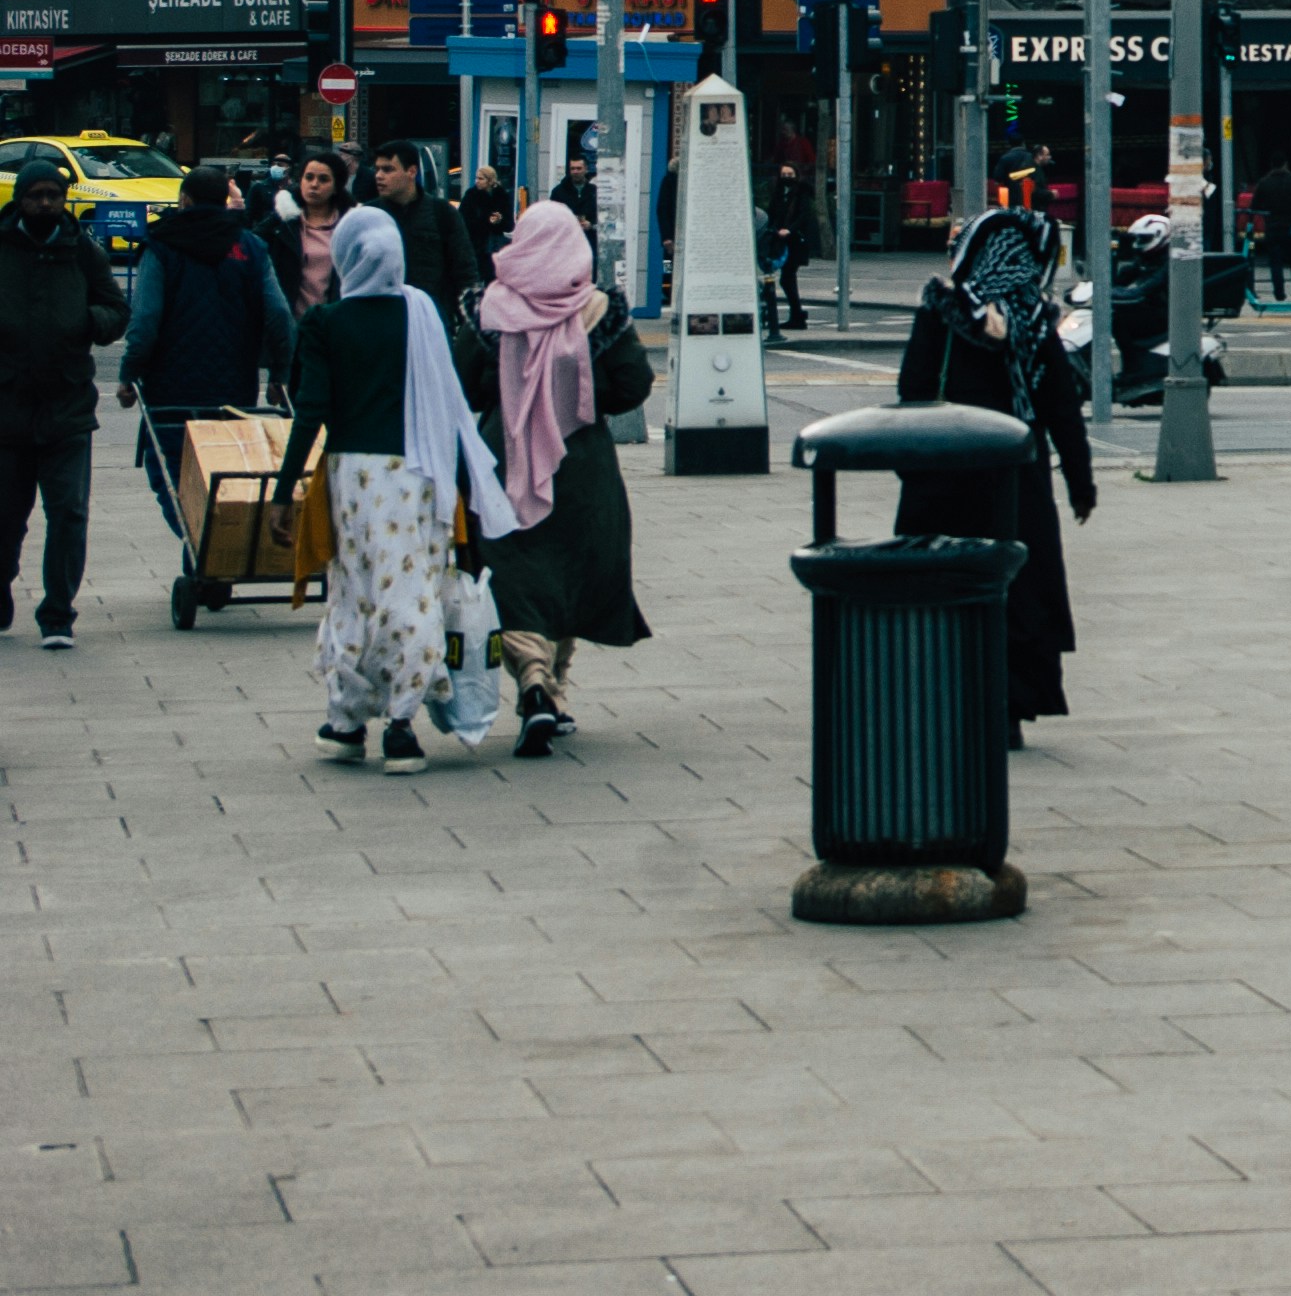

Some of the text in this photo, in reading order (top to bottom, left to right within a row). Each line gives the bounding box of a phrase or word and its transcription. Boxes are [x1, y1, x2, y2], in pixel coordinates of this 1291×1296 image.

[7, 6, 69, 29] KIRTASİYE
[250, 10, 290, 26] & CAFE
[1011, 36, 1144, 62] EXPRSS
